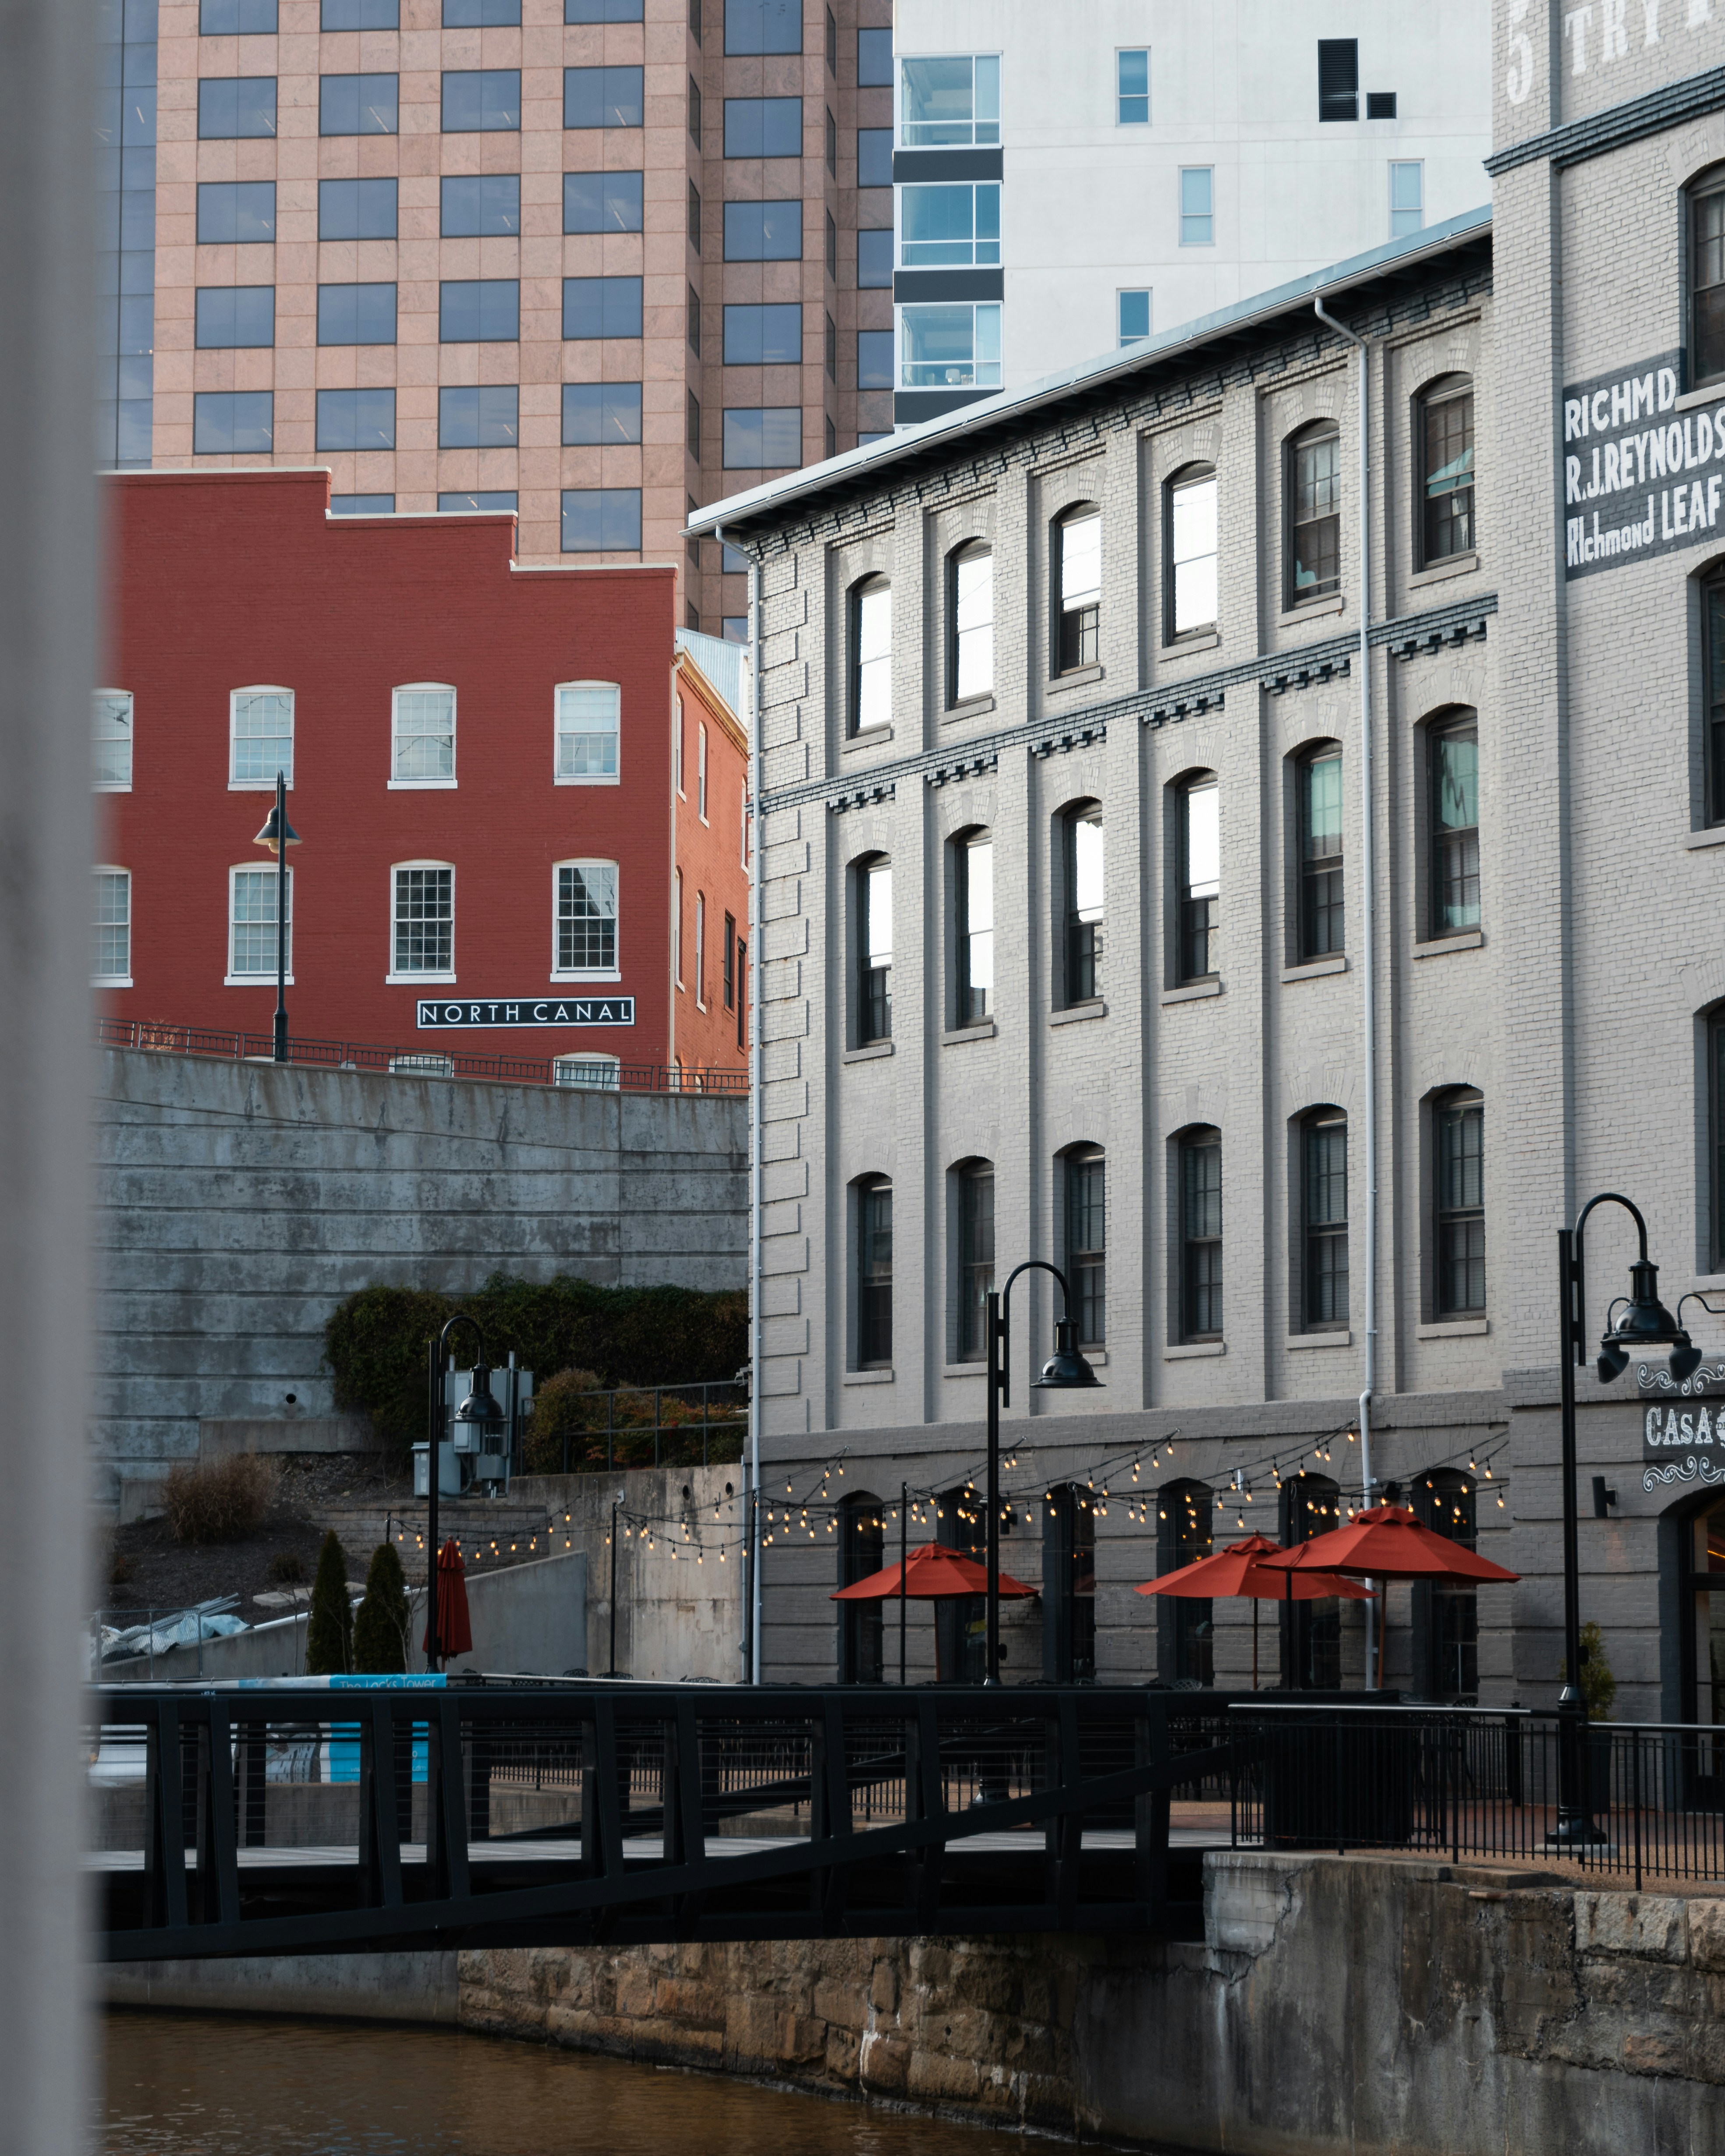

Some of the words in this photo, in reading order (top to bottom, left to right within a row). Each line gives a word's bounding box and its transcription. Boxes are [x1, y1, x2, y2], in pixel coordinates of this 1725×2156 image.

[1565, 367, 1677, 442] RICHMD
[1662, 474, 1722, 541] LEAF
[422, 1005, 519, 1022] NORTH
[533, 1003, 629, 1021] CANAL
[1646, 1406, 1713, 1446] CASA
